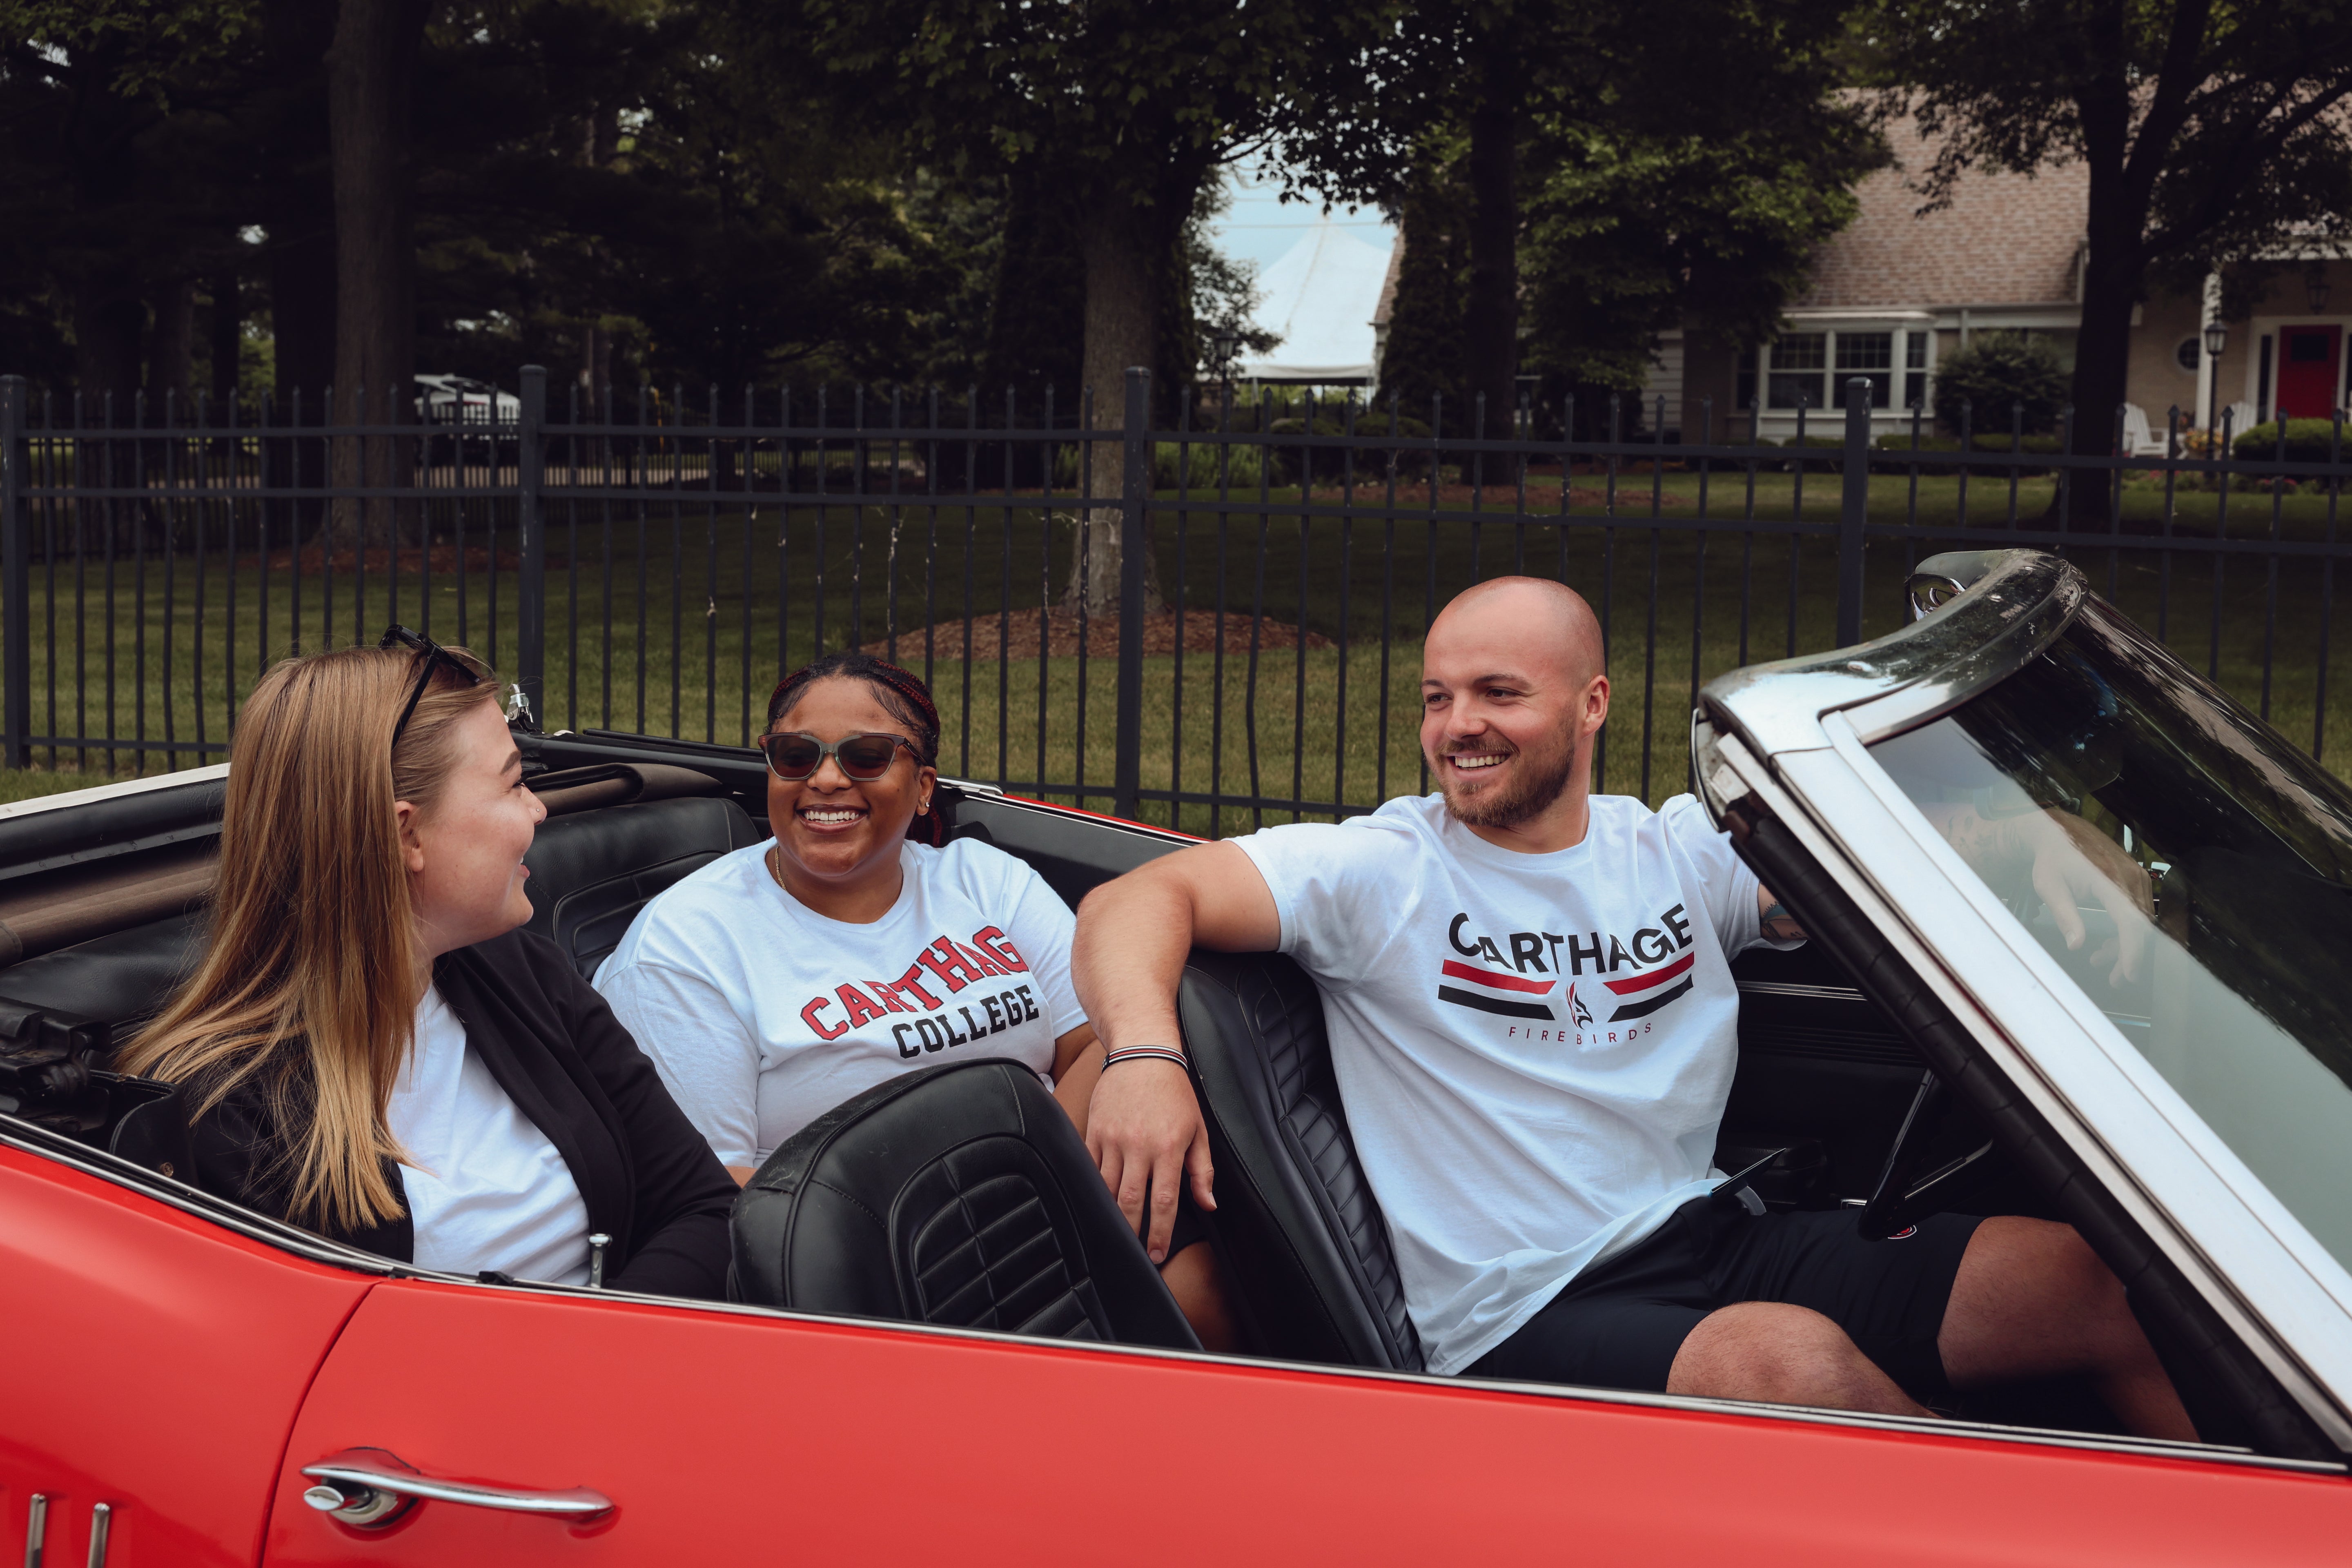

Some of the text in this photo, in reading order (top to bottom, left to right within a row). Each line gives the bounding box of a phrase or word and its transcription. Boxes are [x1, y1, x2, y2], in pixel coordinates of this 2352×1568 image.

[1449, 903, 1693, 976] CARTHAGE
[800, 925, 1029, 1041] CARTHAG
[891, 984, 1039, 1059] COLLEGE
[1509, 1022, 1651, 1045] FIREBIRDS
